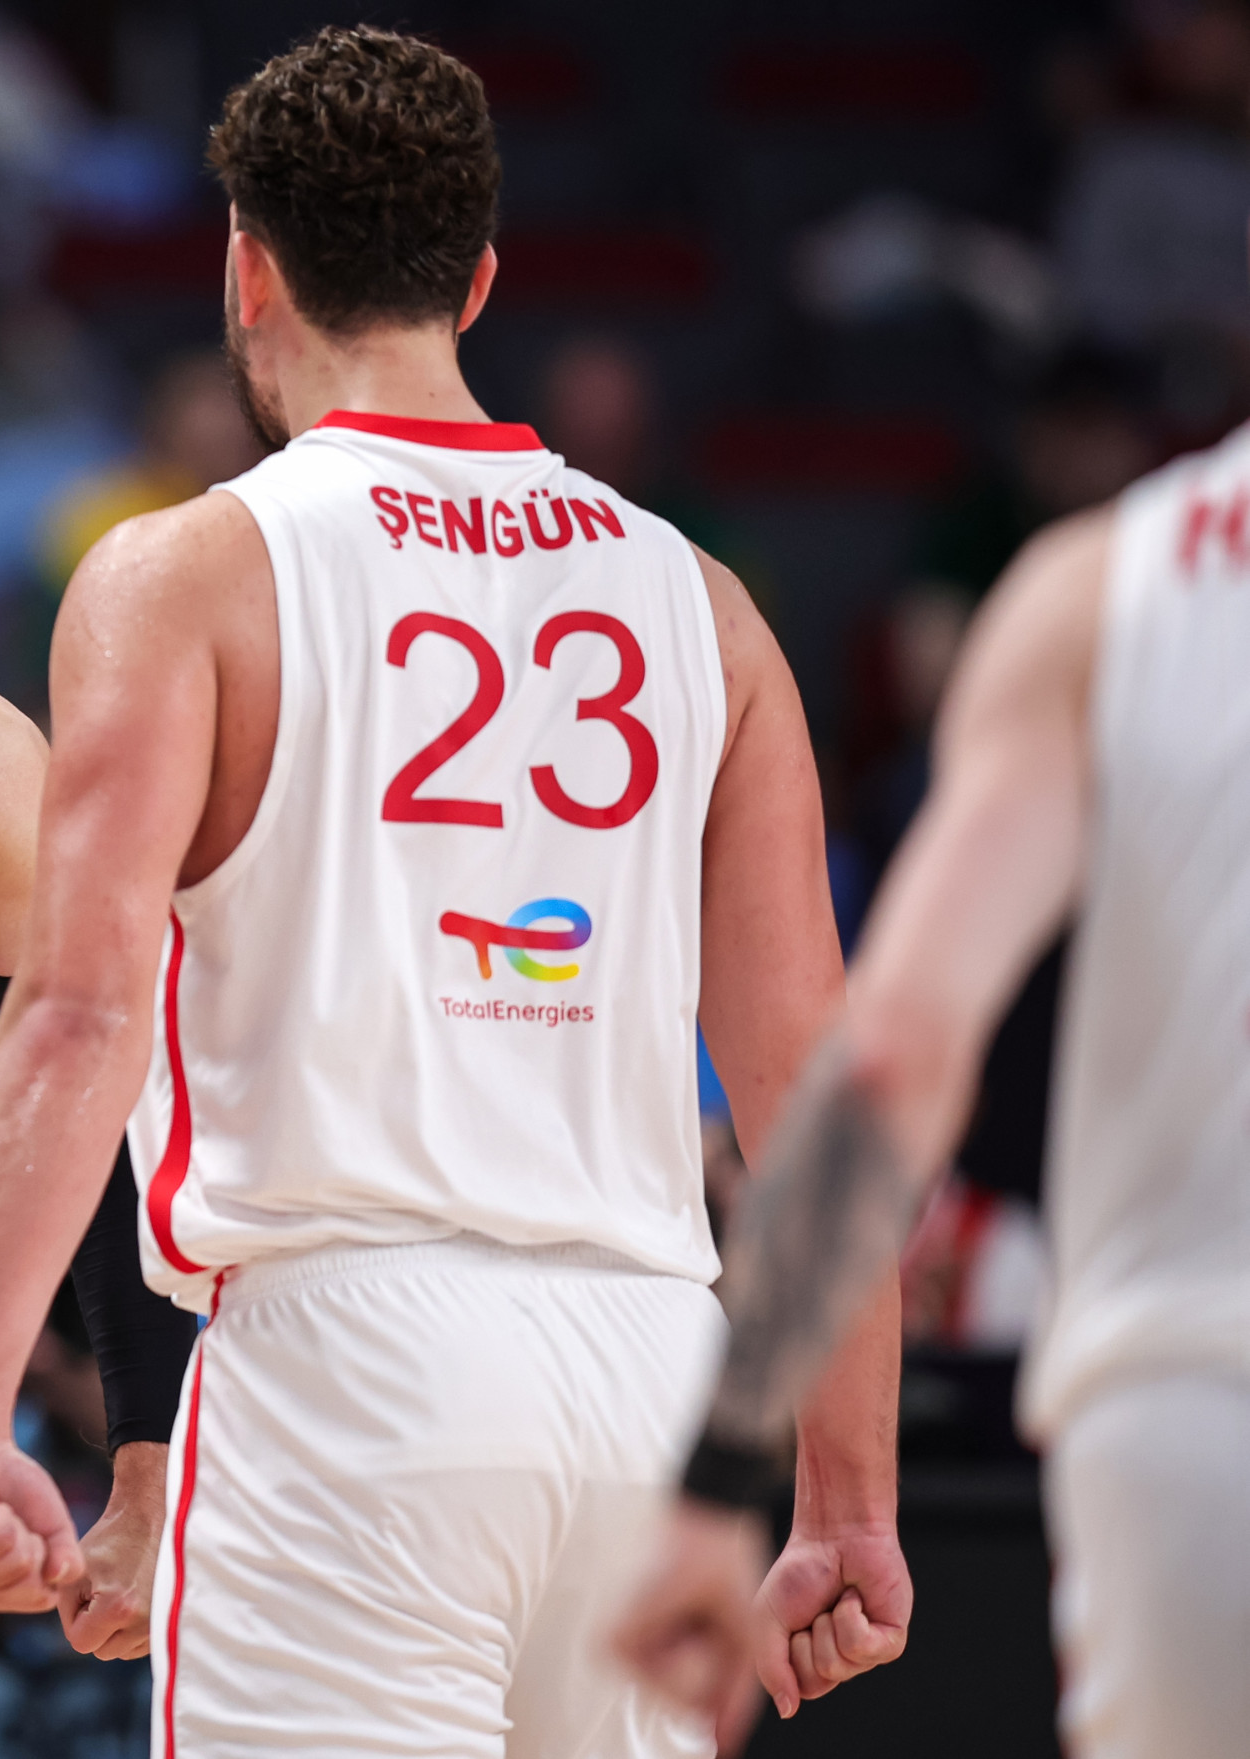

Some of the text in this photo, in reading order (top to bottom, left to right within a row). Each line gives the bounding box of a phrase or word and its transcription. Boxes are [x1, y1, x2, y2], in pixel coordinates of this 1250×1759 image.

[369, 485, 626, 558] ŞENGÜN
[381, 610, 659, 830] 23
[439, 996, 595, 1028] TotalEnergies
